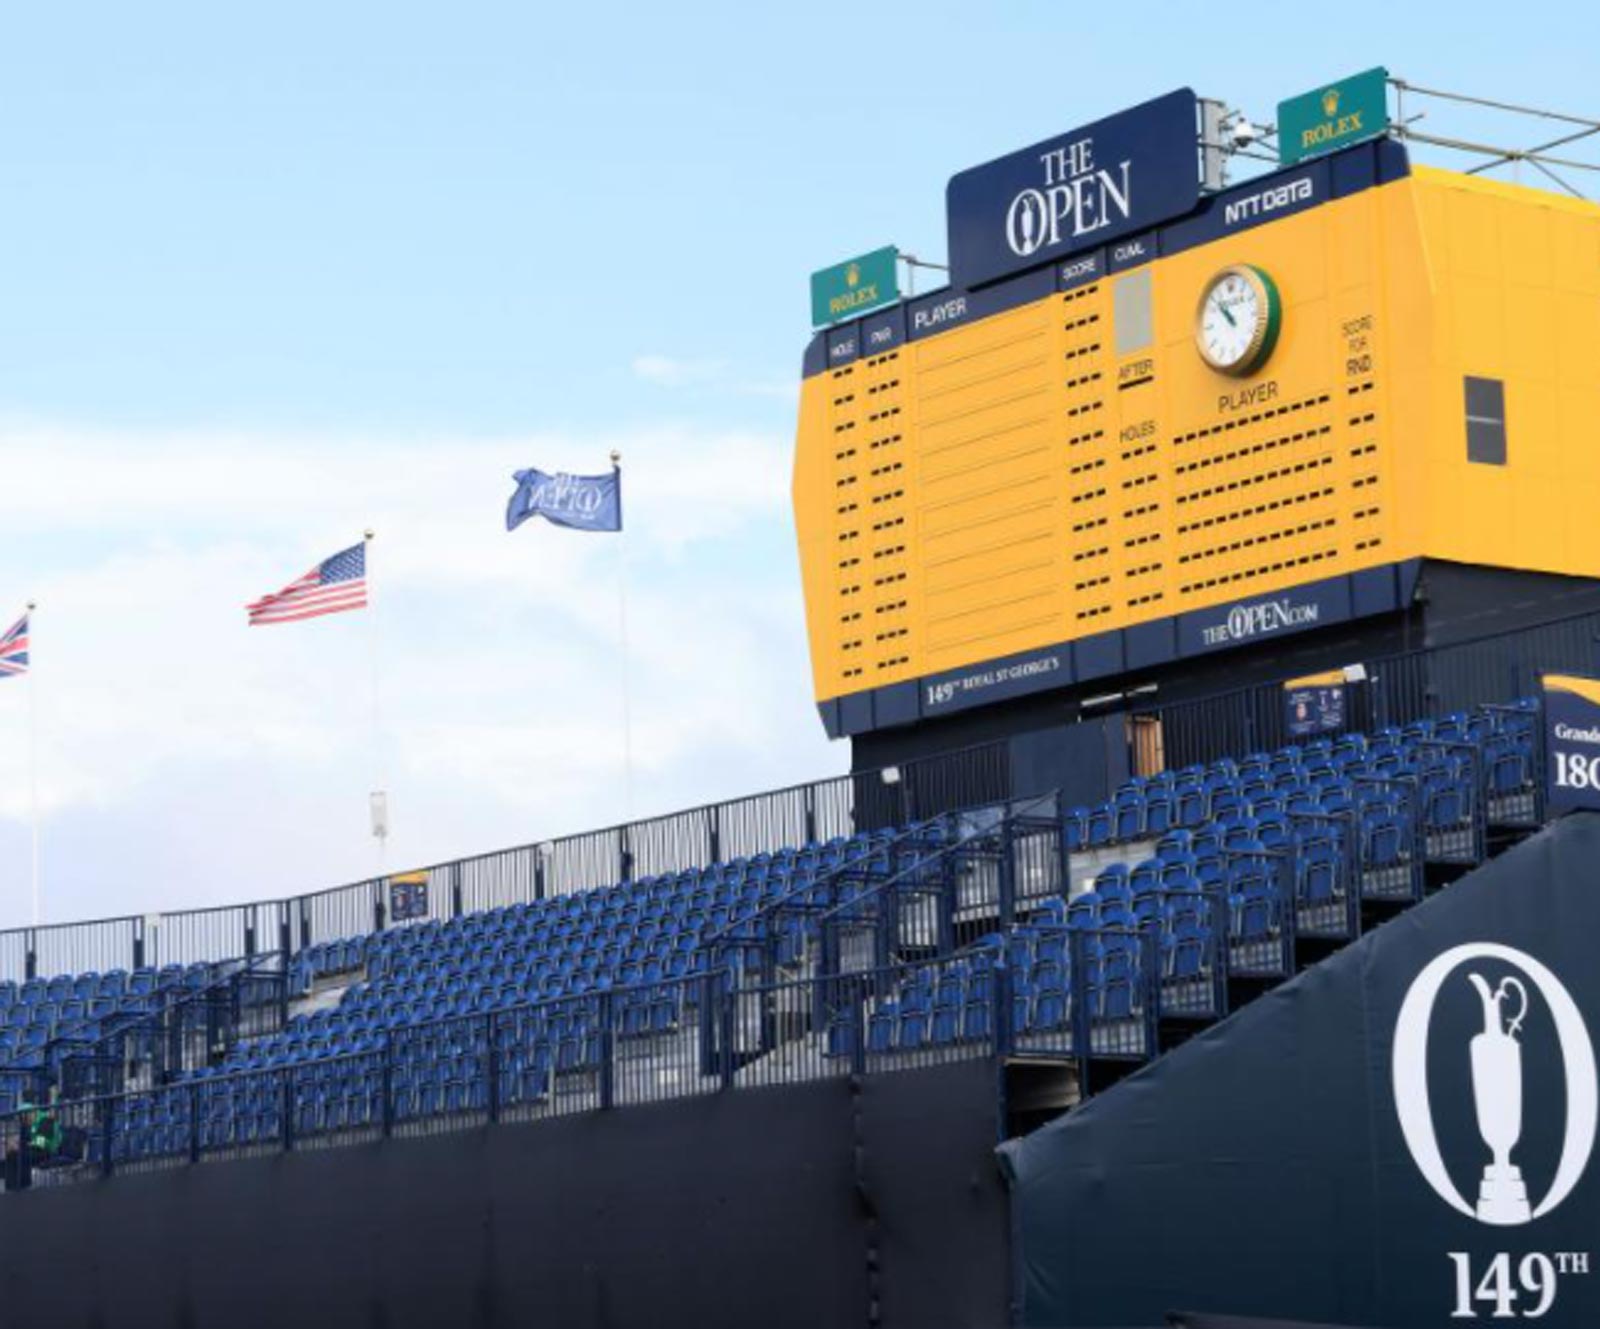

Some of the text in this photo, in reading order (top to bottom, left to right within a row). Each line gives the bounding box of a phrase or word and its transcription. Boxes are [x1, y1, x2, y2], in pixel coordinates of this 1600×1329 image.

[1302, 110, 1362, 148] ROLEX
[1040, 138, 1095, 185] THE
[1006, 160, 1132, 256] OPEN
[1225, 194, 1261, 224] NTT
[1063, 258, 1096, 280] SCORE
[830, 286, 878, 313] ROLEX
[914, 297, 967, 329] PLAYER
[1118, 359, 1153, 381] AFTER
[1218, 381, 1278, 413] PLAYER
[1119, 420, 1155, 443] HOLES
[1555, 722, 1600, 744] Grand
